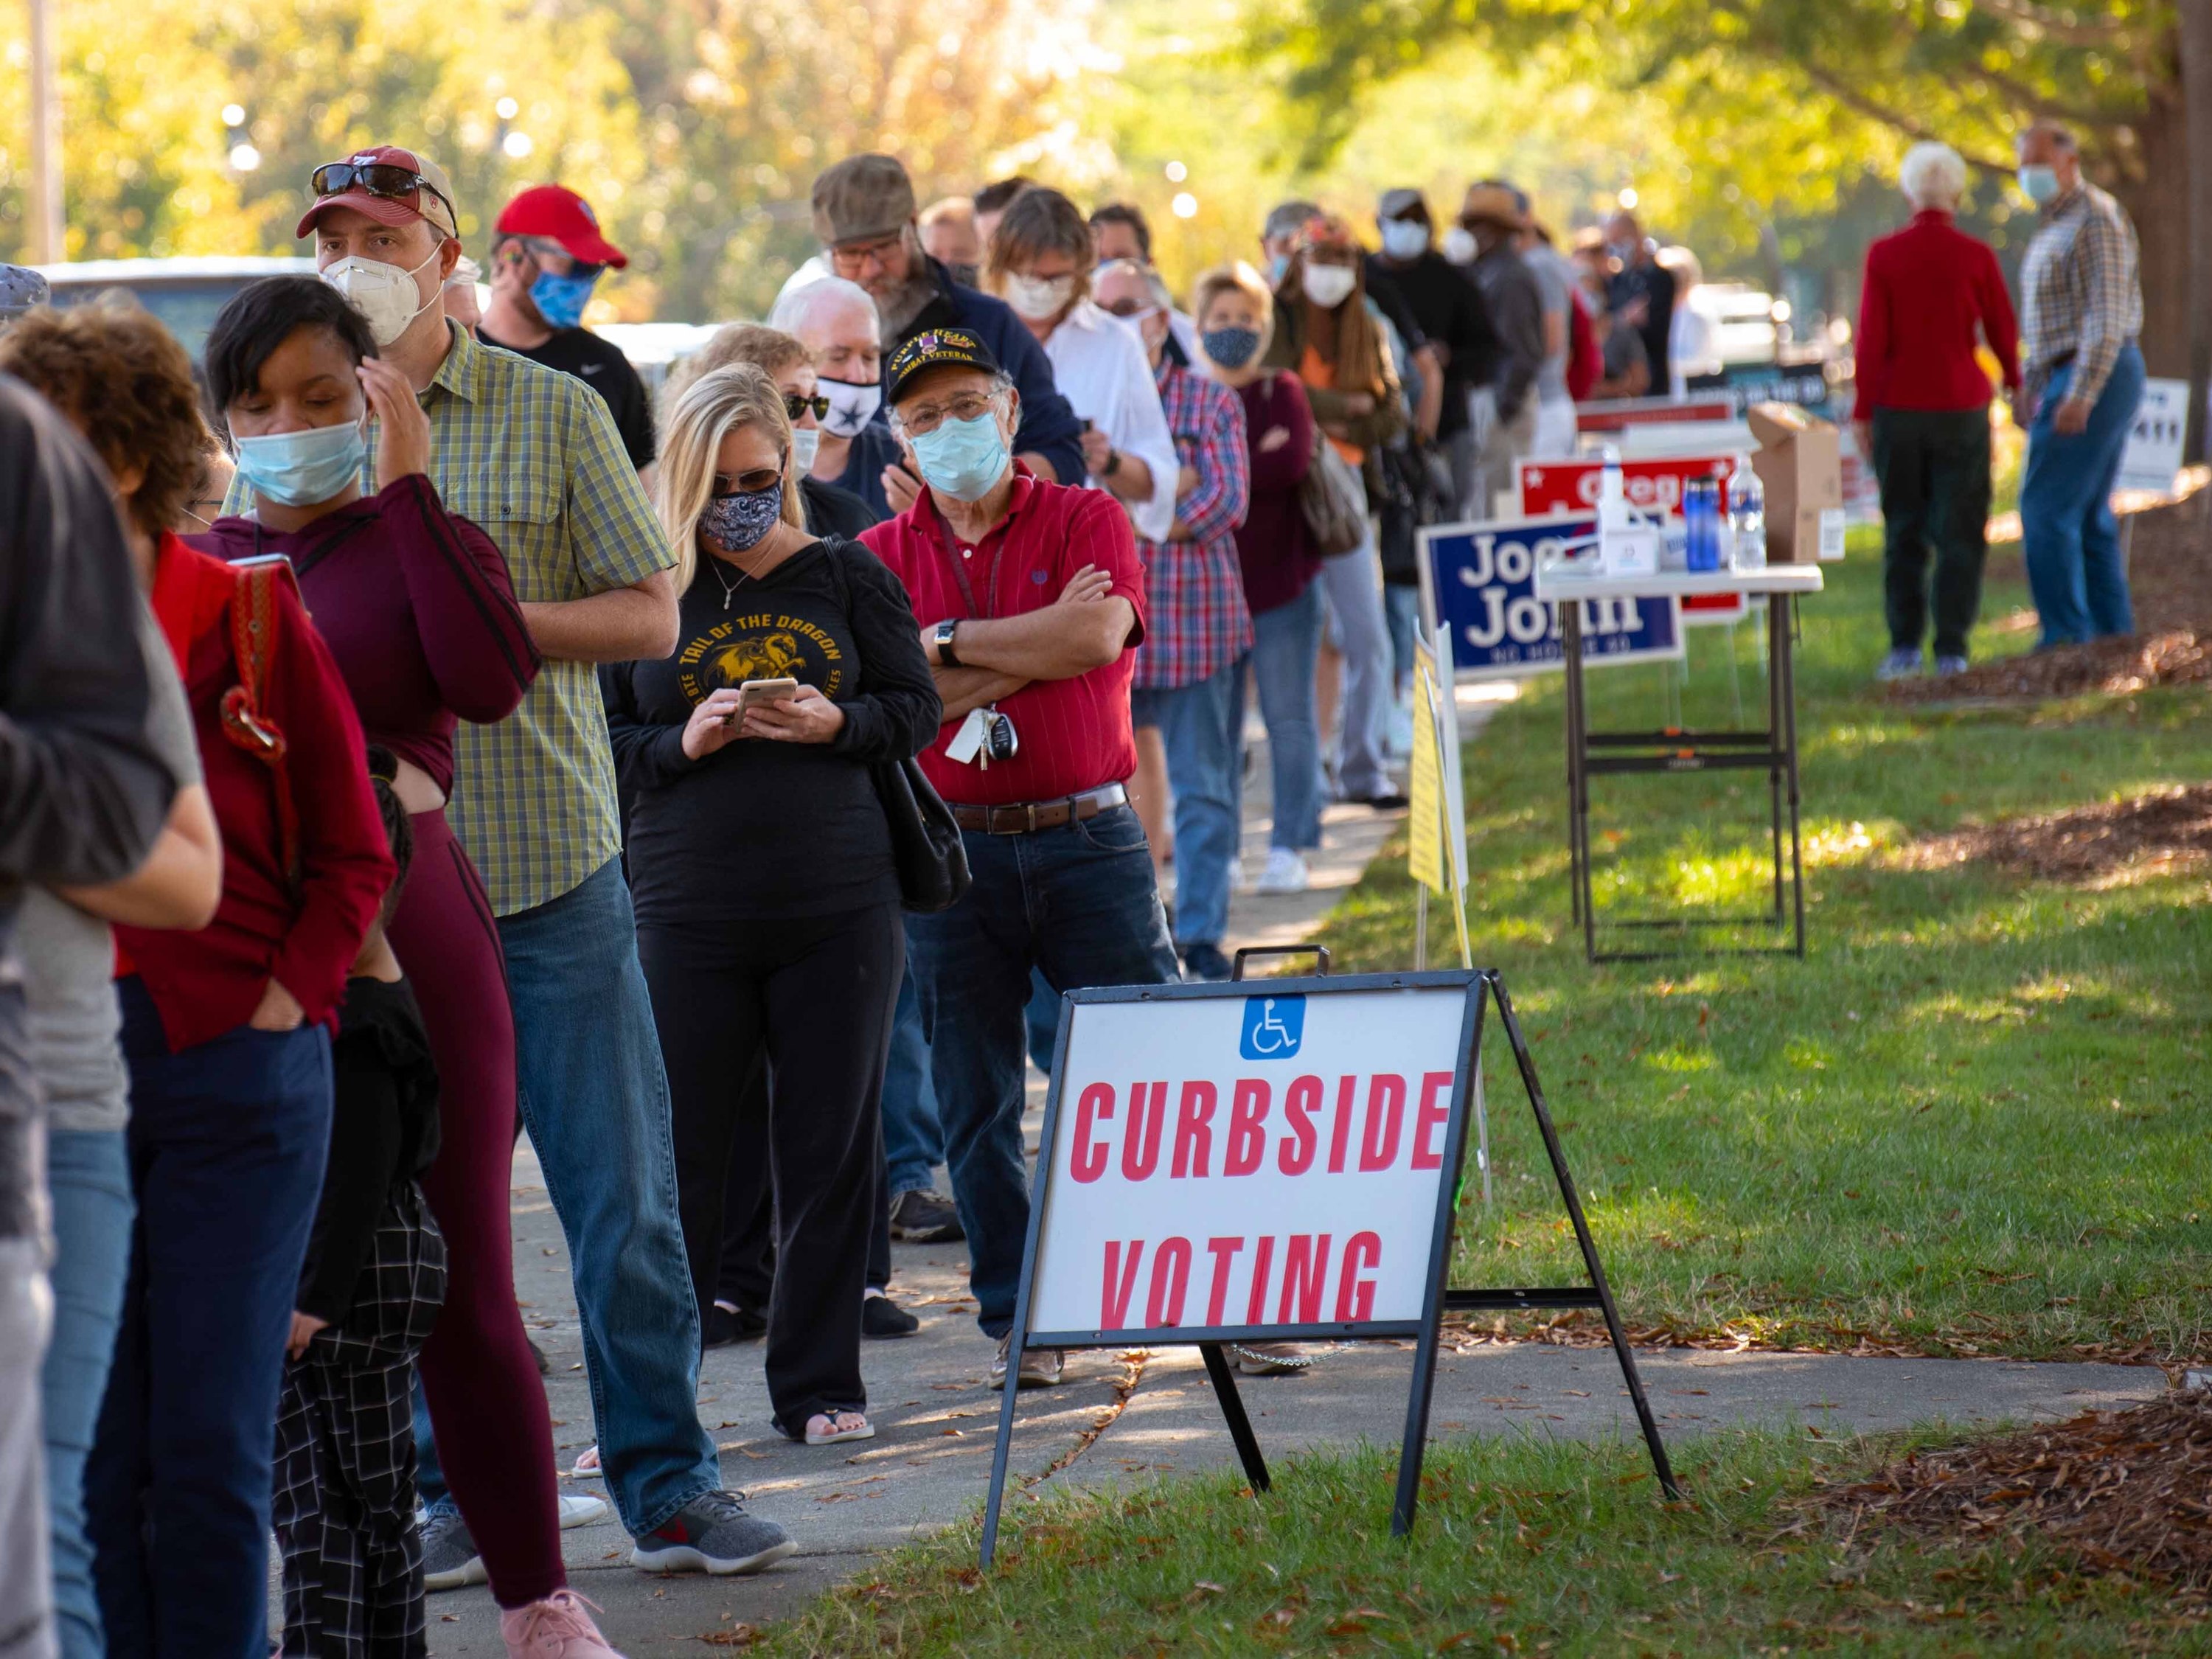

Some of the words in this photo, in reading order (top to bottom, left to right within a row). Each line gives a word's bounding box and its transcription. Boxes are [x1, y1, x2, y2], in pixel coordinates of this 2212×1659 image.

[929, 350, 973, 361] VETERAN
[933, 329, 976, 348] HEART
[679, 637, 714, 664] TAIL
[709, 622, 734, 640] OF
[737, 614, 771, 630] THE
[776, 615, 842, 661] DRAGON
[1070, 1071, 1454, 1183] CURBSIDE
[1100, 1231, 1382, 1330] VOTING
